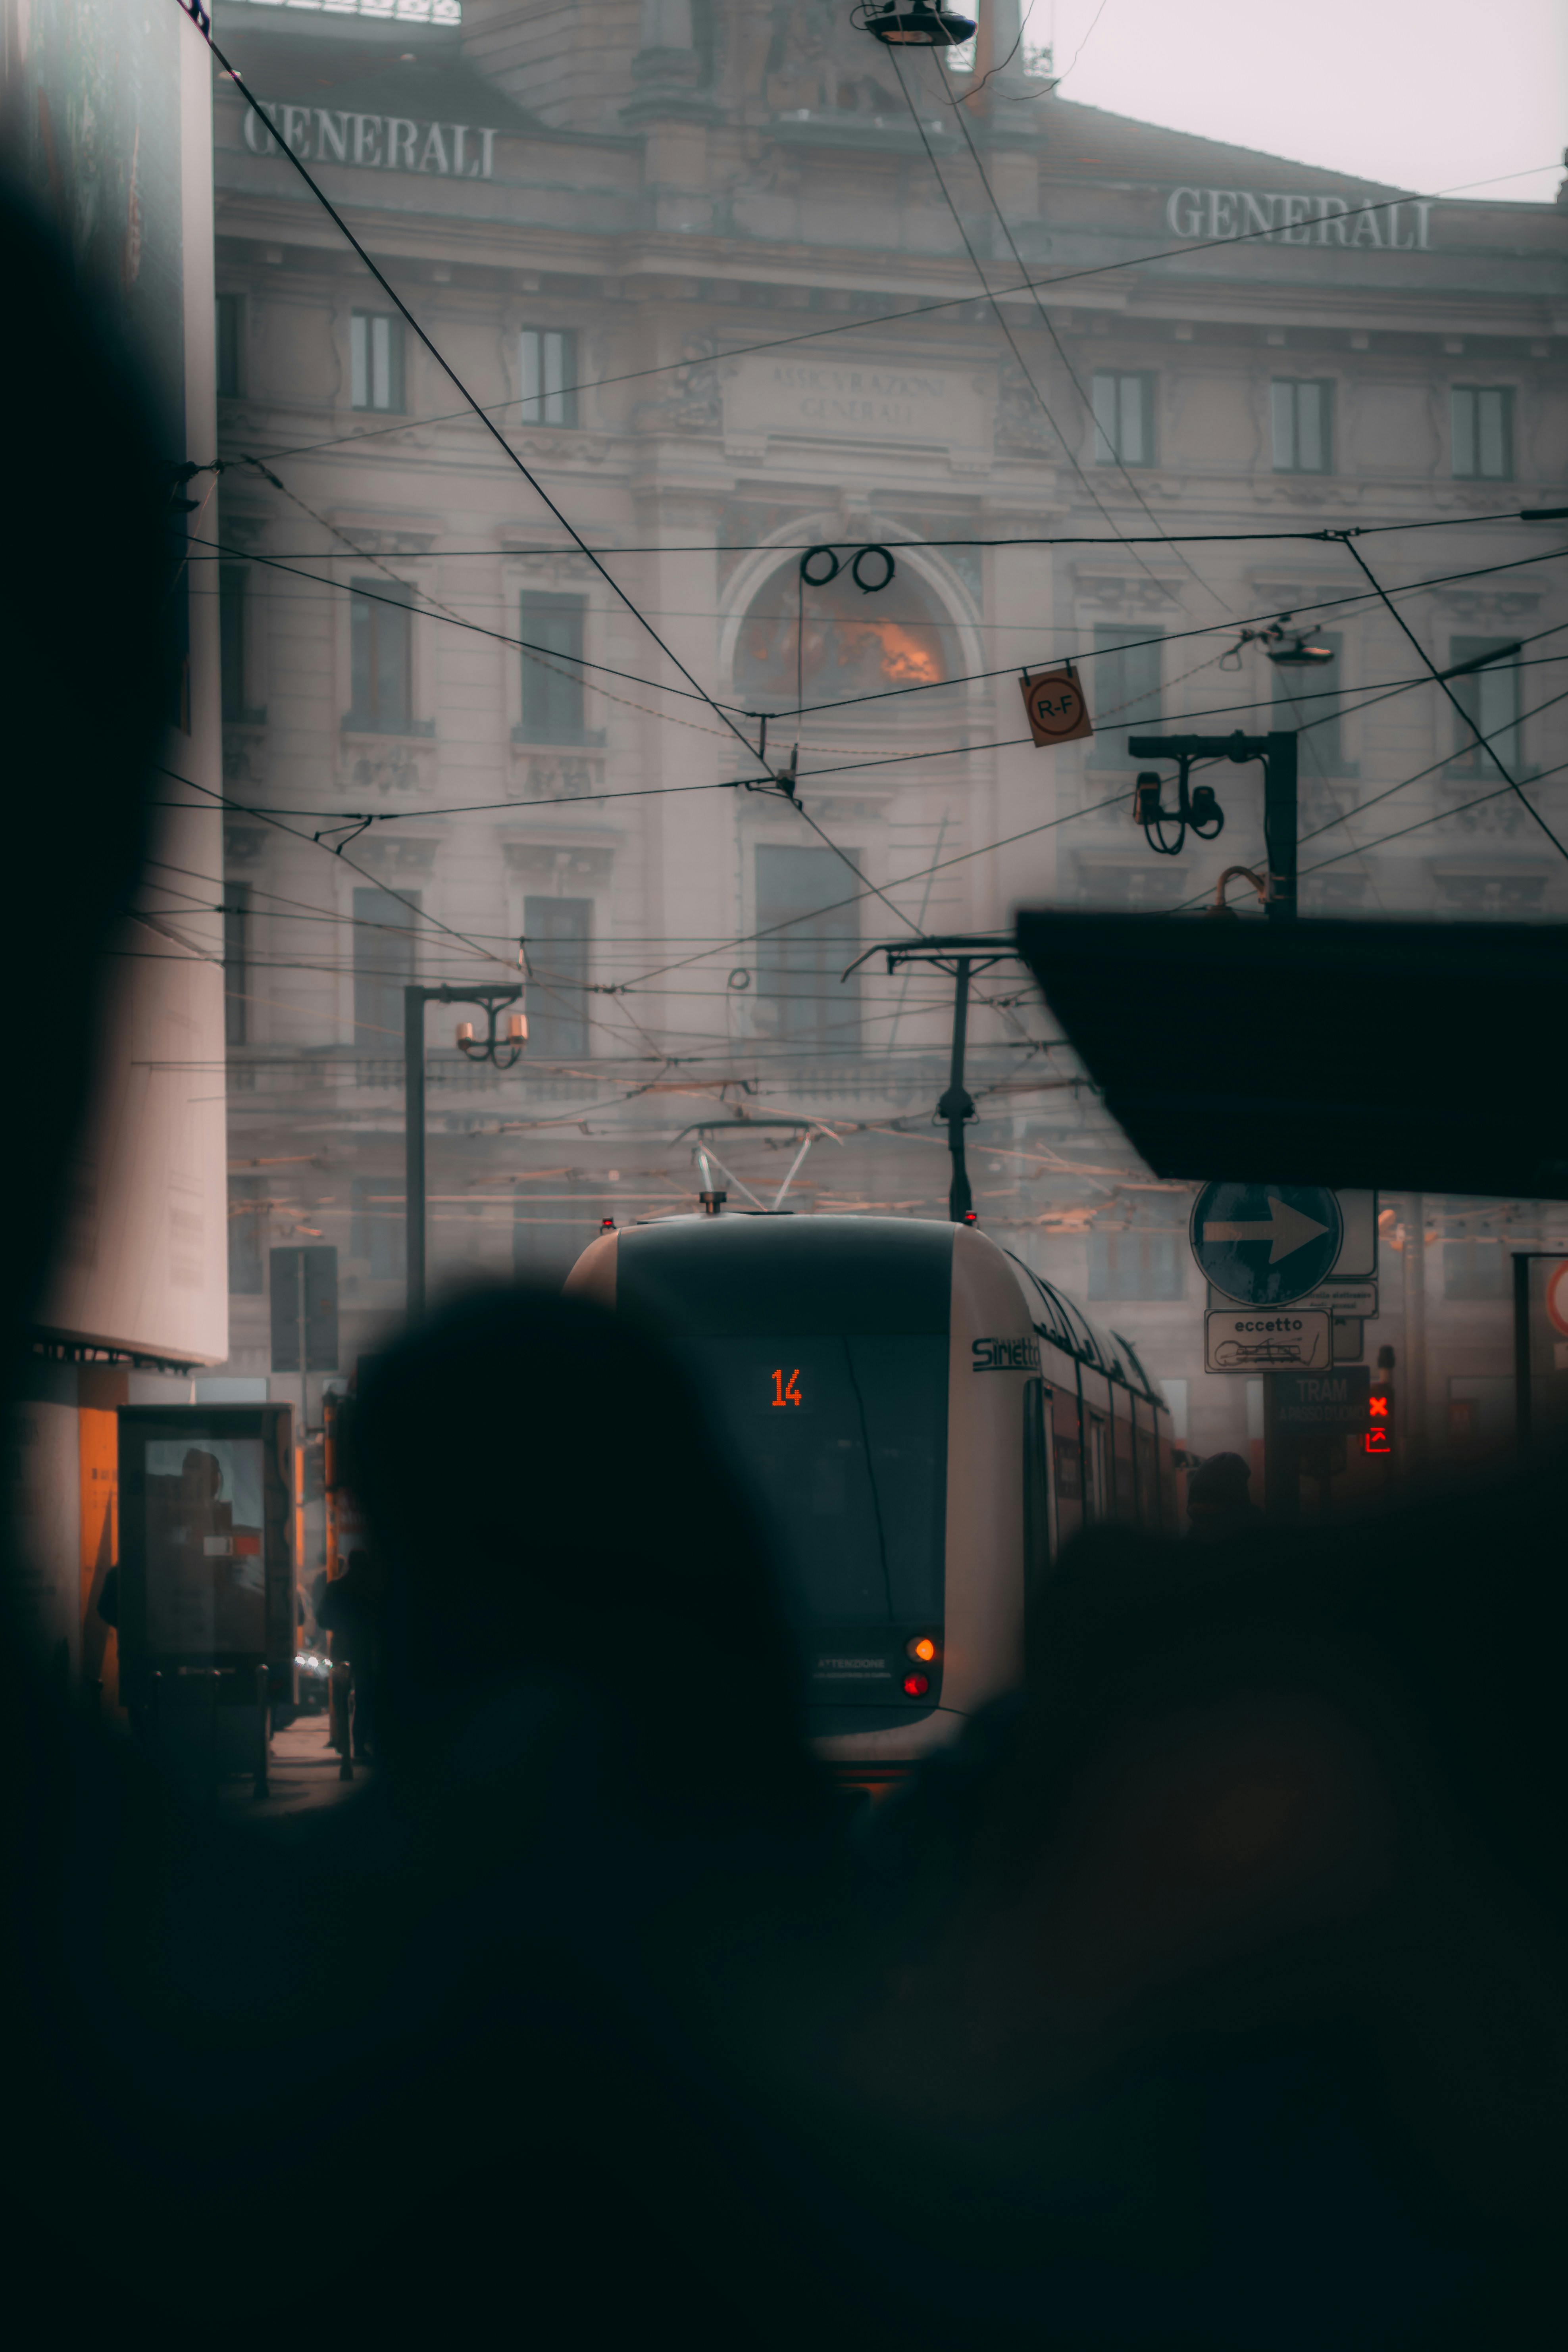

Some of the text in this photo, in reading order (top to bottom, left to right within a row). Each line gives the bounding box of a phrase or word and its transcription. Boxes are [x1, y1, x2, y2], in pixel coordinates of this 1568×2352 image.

[244, 100, 498, 179] GENERALI
[1166, 187, 1433, 251] GENERALI
[1037, 695, 1073, 719] R-F
[1235, 1317, 1302, 1332] eccetto
[772, 1369, 802, 1406] 14
[1296, 1379, 1347, 1402] TRAM
[1279, 1406, 1287, 1421] A
[1289, 1406, 1322, 1422] PASSO
[818, 1659, 885, 1668] ATTENZIONE
